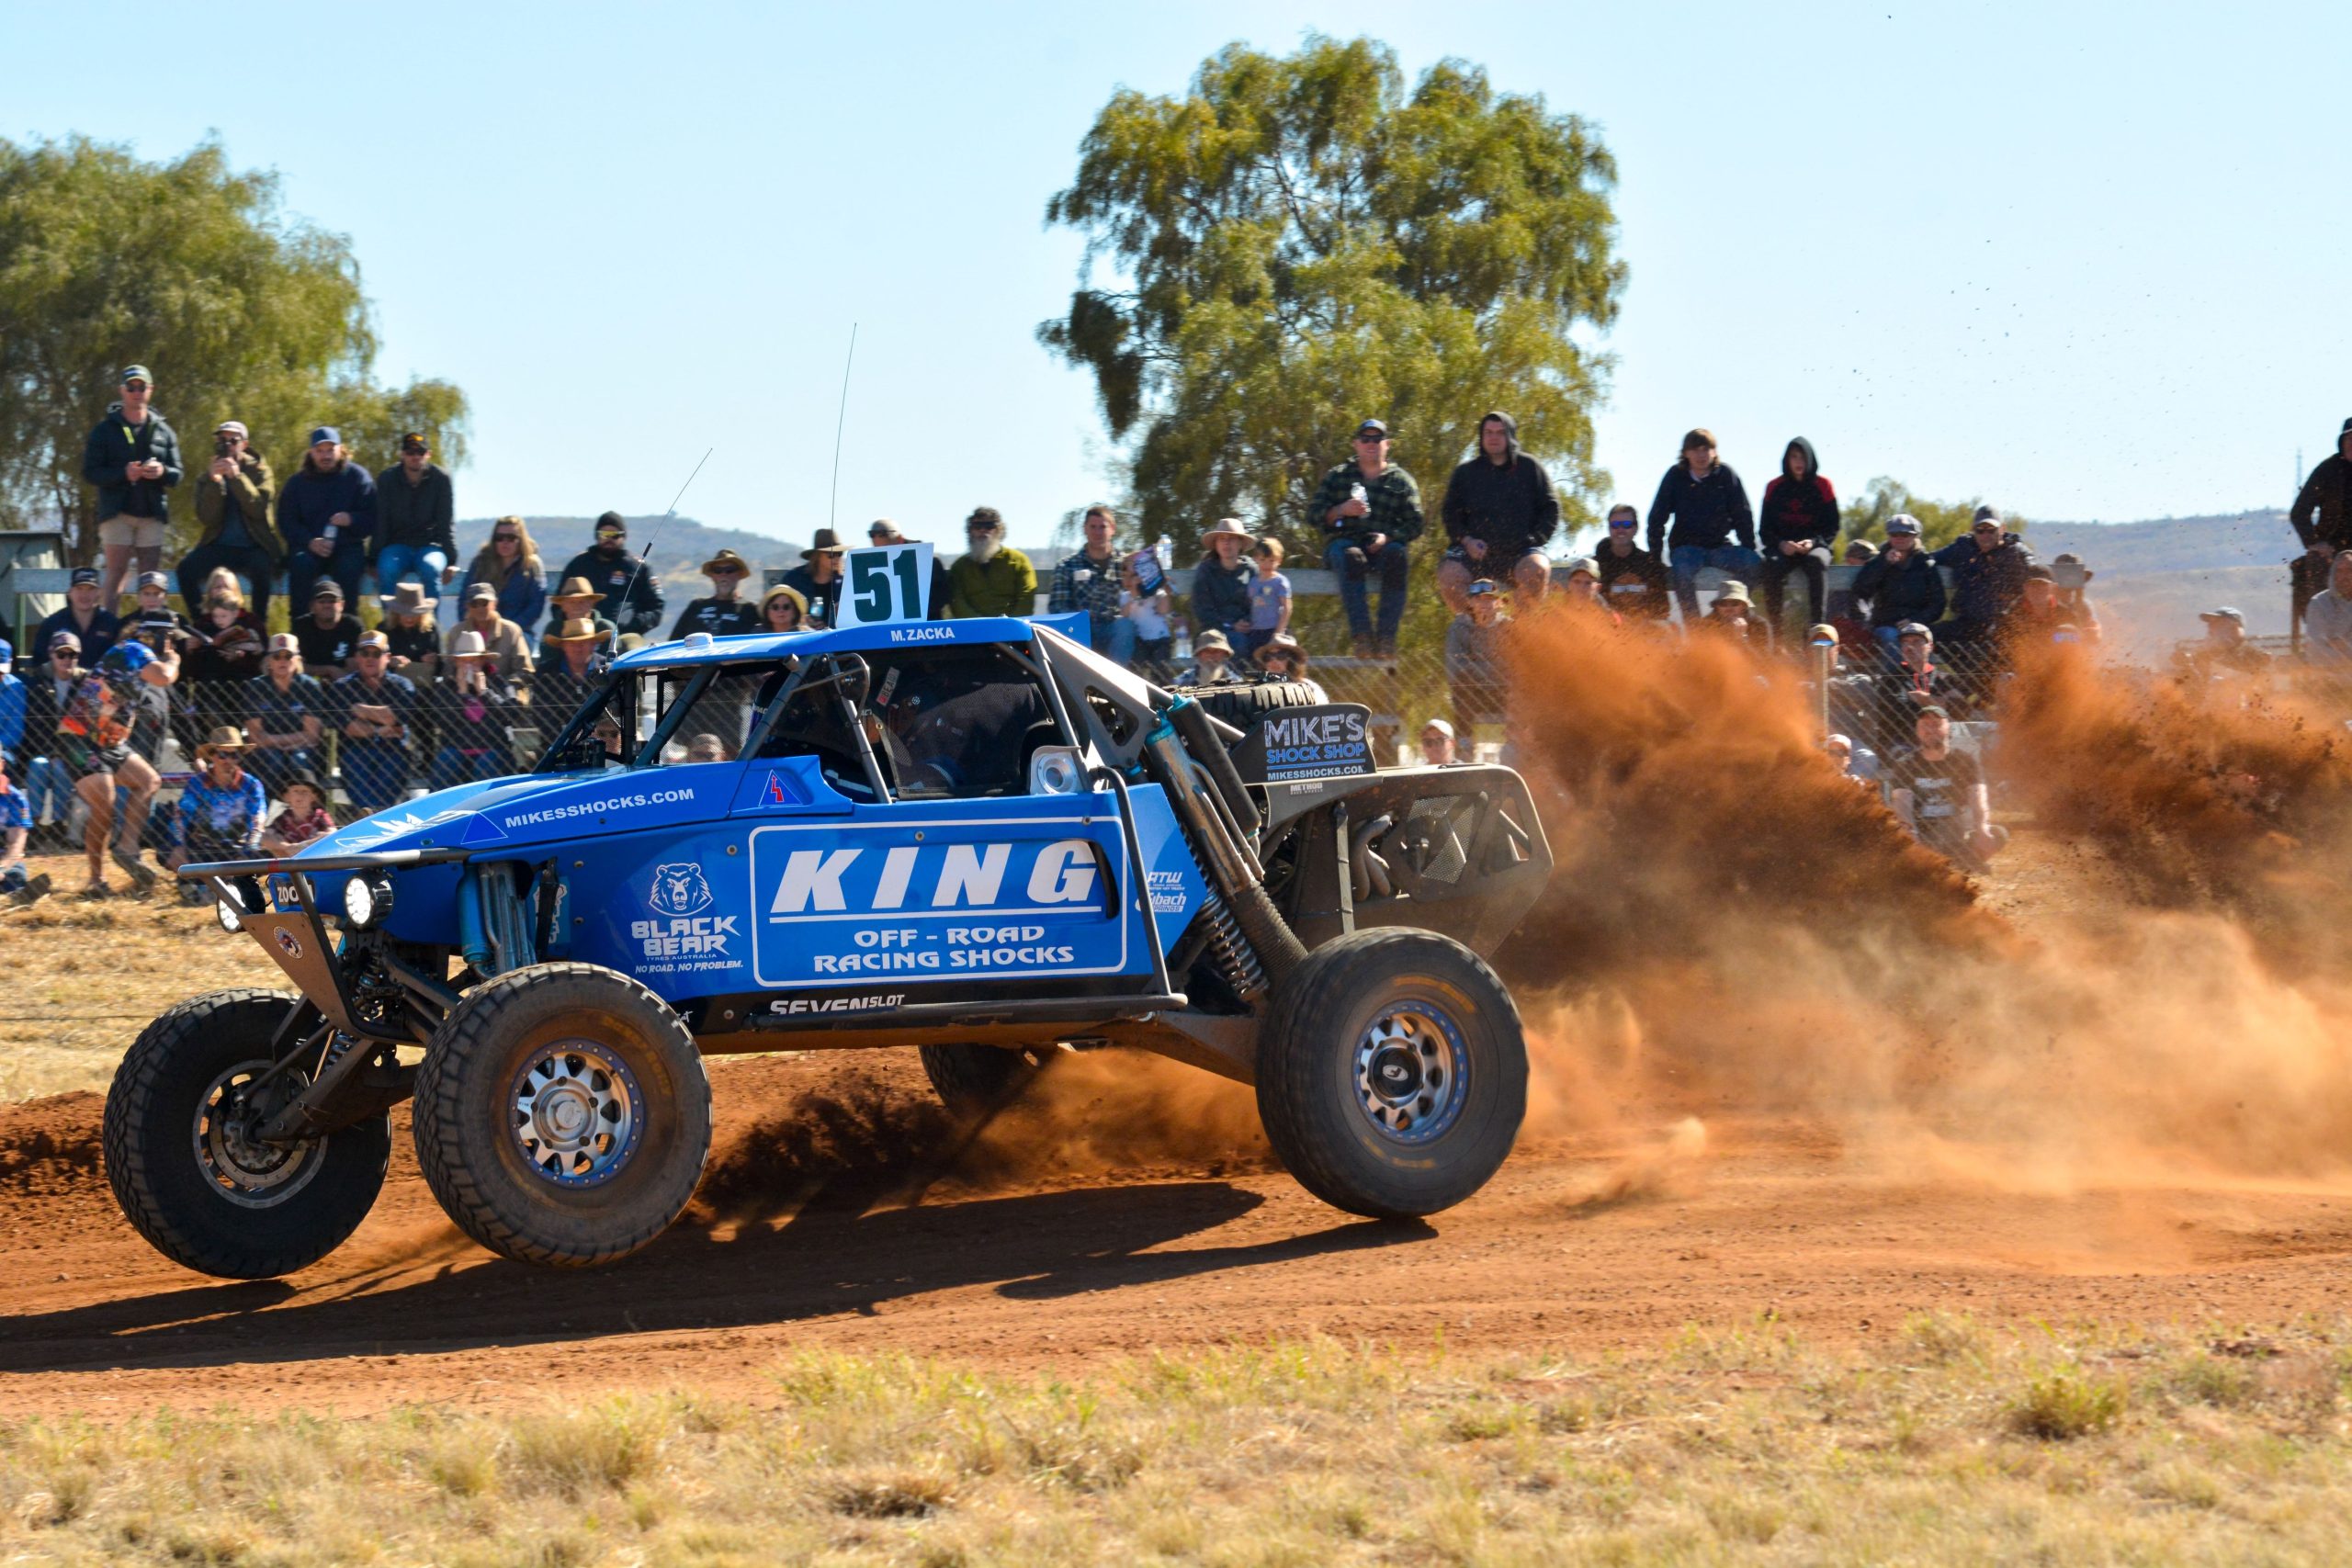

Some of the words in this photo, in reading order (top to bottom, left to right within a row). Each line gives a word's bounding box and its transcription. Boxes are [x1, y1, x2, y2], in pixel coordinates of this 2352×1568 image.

[851, 549, 922, 623] 51
[890, 627, 956, 642] M.ZACKA
[1263, 713, 1364, 748] MIKE'S
[1266, 746, 1321, 764] SHOCK
[1323, 742, 1365, 760] SHOP
[504, 788, 695, 829] MIKESSHOCKS.COM
[770, 840, 1098, 913] KING
[277, 885, 313, 903] ZOO
[630, 916, 741, 939] BLACK
[854, 929, 918, 948] OFF
[947, 926, 1045, 945] ROAD
[643, 935, 730, 956] BEAR
[635, 964, 648, 974] NO
[649, 964, 676, 974] ROAD.
[678, 963, 693, 973] NO
[694, 960, 744, 972] PROBLEM.
[813, 953, 940, 974] RACING
[950, 946, 1075, 967] SHOCKS
